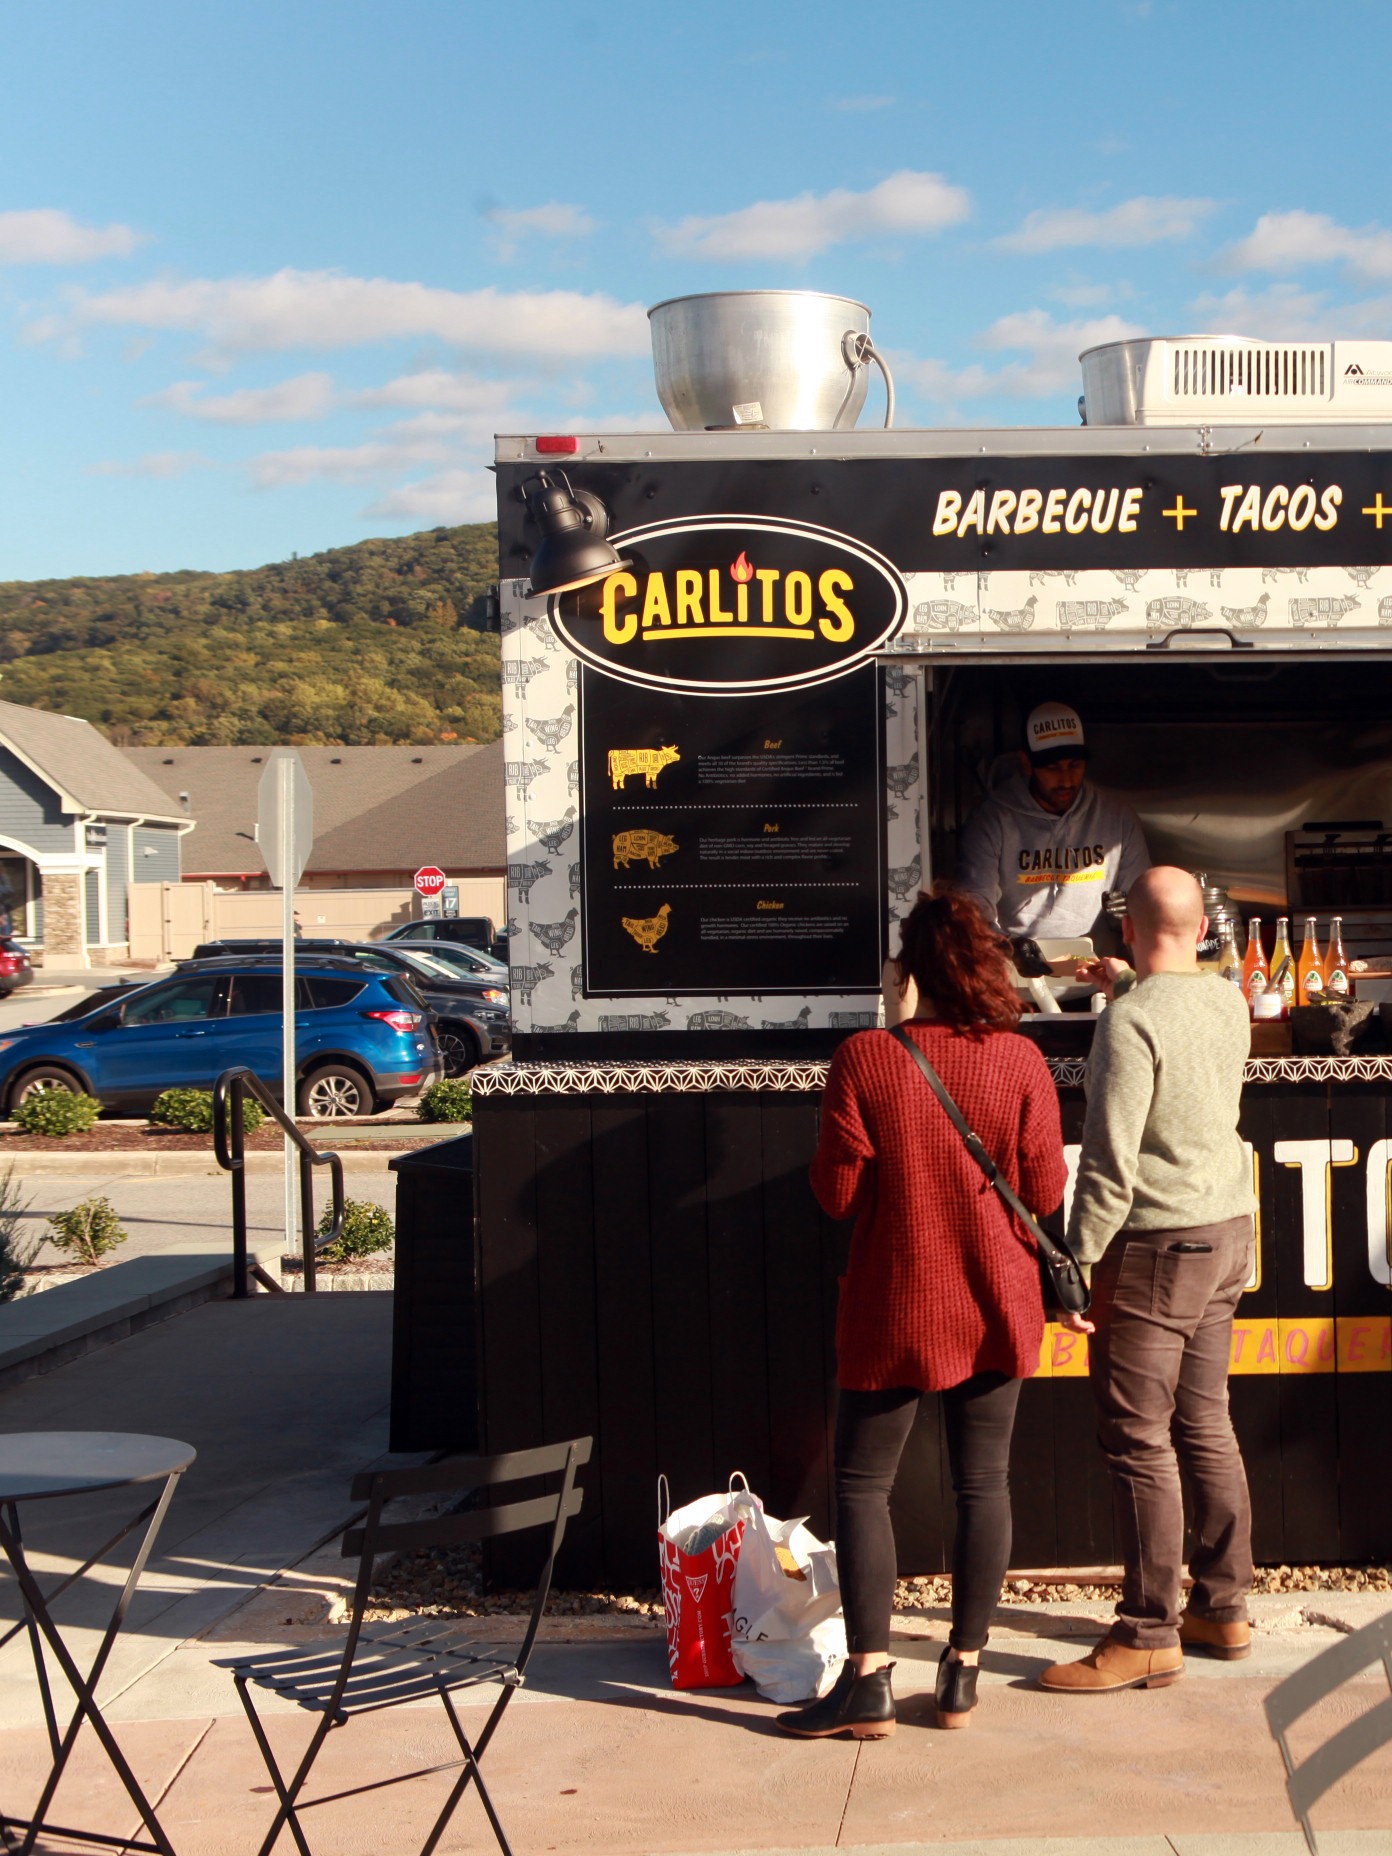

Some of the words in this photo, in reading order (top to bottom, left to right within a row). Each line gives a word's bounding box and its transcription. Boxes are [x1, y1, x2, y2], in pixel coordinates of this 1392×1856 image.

[932, 487, 1143, 537] BARBECUE
[1219, 484, 1342, 533] TACOS
[599, 565, 855, 645] CARLITOS
[1034, 718, 1076, 735] CARLITOS
[764, 740, 782, 750] Beef
[763, 824, 780, 834] Pork
[1019, 844, 1104, 870] CARLITOS
[417, 875, 443, 888] STOP
[446, 898, 456, 908] 17
[756, 901, 784, 910] Chicken
